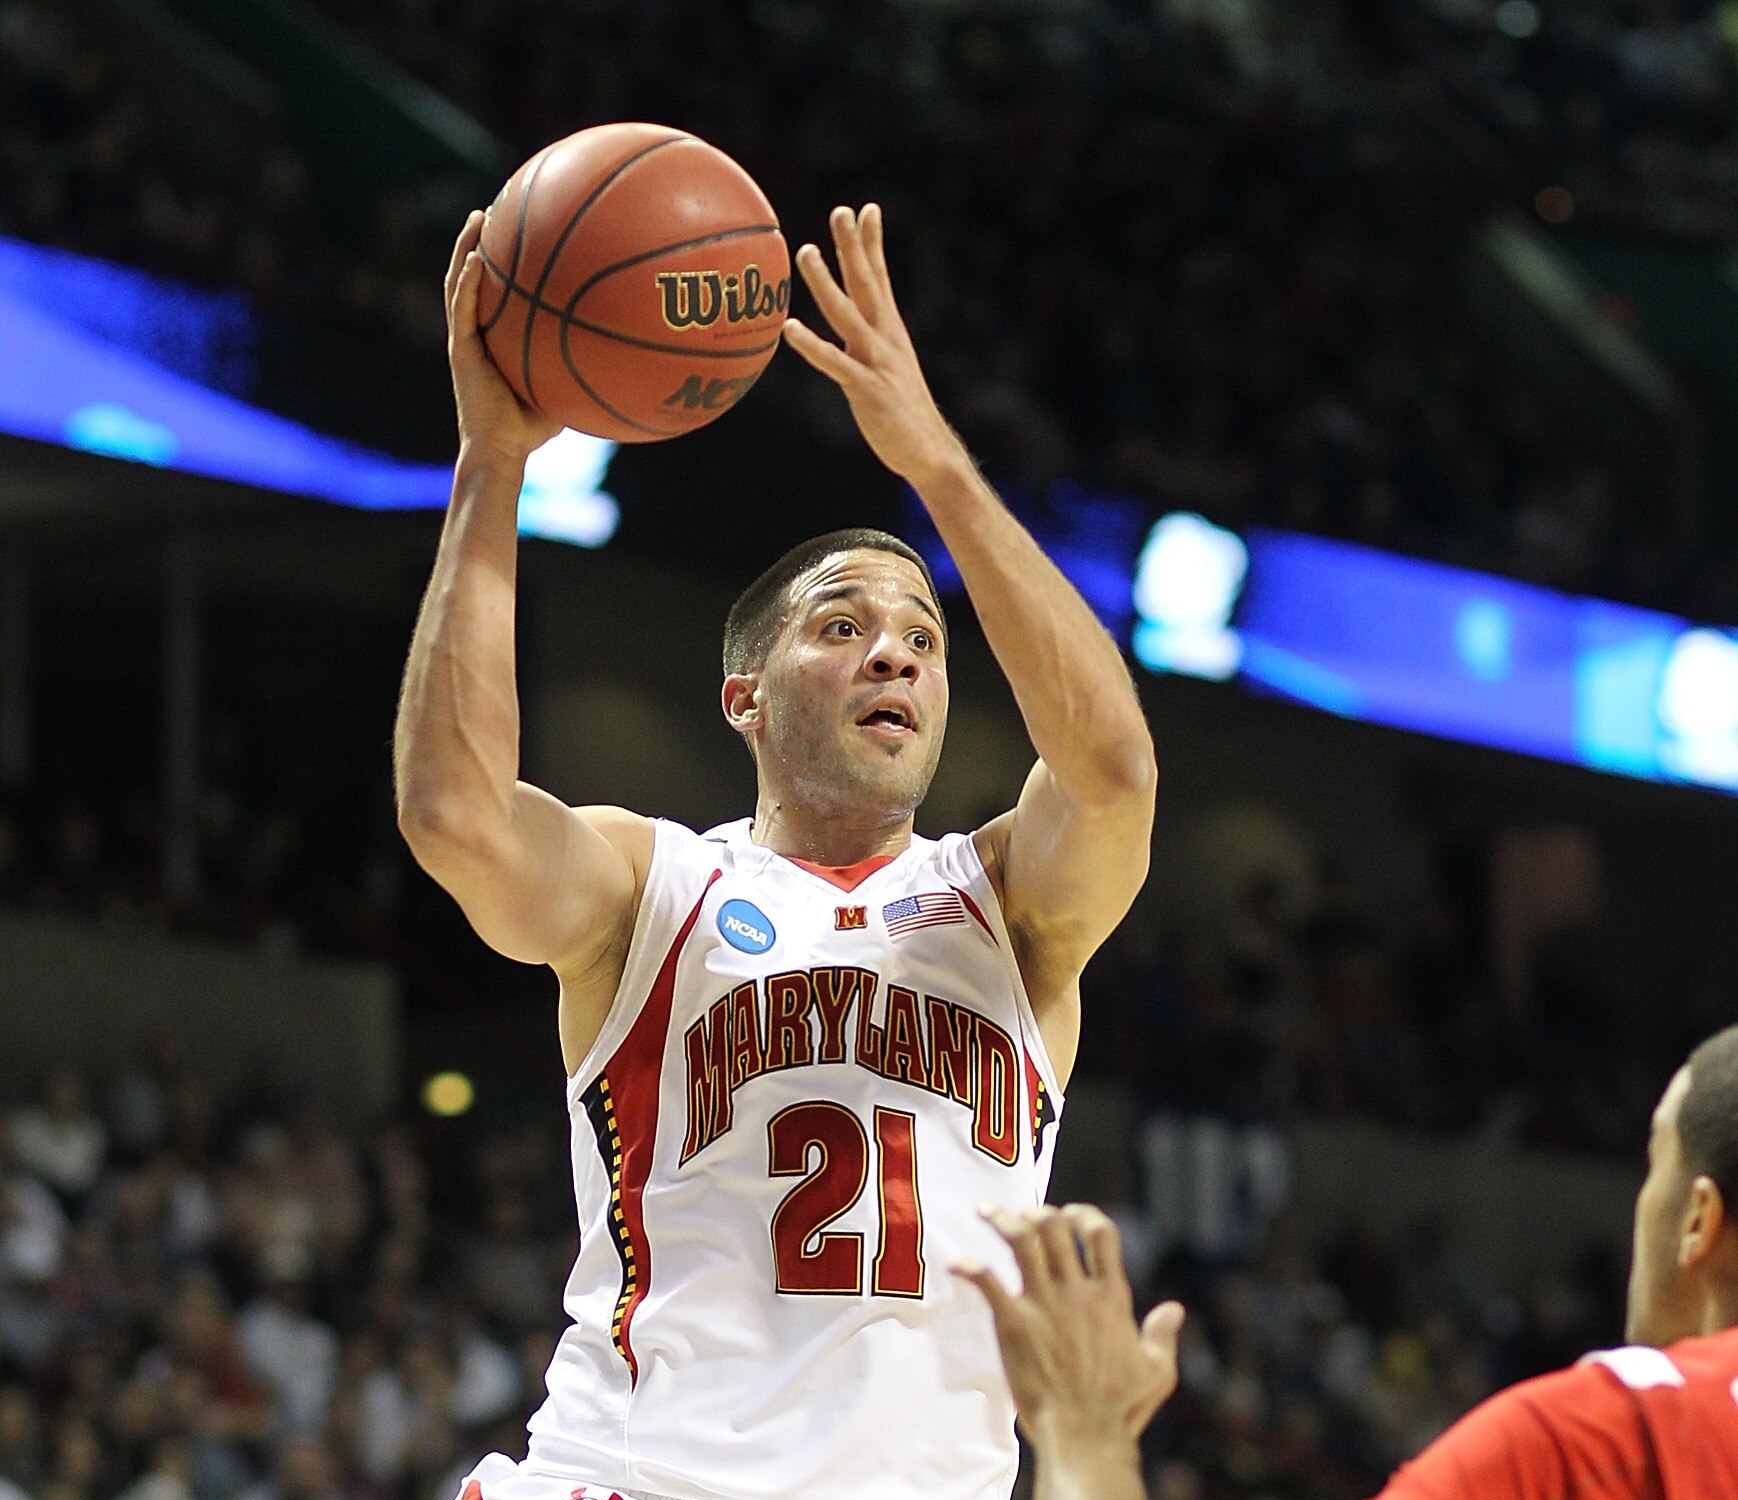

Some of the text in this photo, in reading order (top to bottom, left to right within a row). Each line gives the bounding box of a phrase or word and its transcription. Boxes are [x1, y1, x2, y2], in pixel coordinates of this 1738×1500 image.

[724, 915, 769, 946] NCAA
[834, 905, 868, 931] M
[679, 966, 1020, 1168] MARYLAND
[767, 1100, 925, 1299] 21
